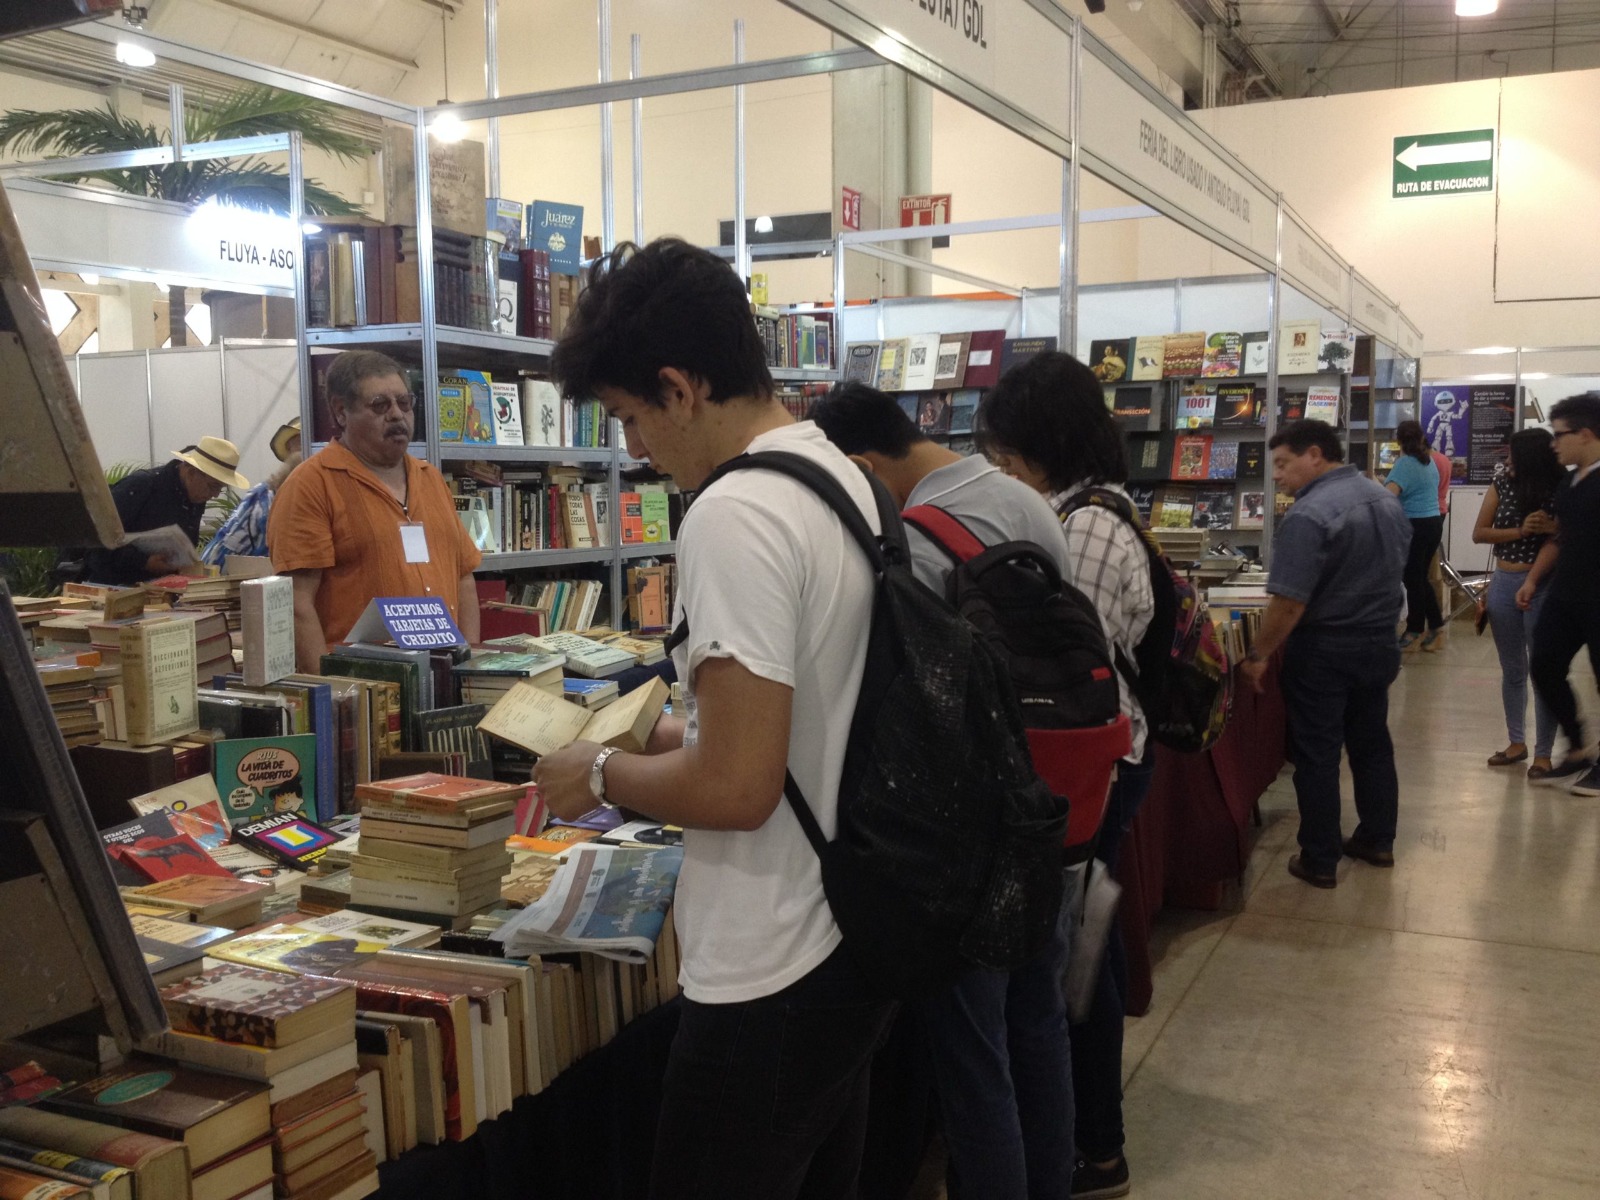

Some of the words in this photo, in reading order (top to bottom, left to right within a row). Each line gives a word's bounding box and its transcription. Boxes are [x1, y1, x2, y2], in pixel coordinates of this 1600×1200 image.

[963, 0, 987, 49] GDL
[1140, 118, 1157, 160] FERIA
[1158, 132, 1169, 169] DEL
[1170, 141, 1186, 180] LIBRO
[1396, 182, 1419, 193] RUTA
[1420, 180, 1433, 191] DE
[1433, 176, 1489, 191] EVACUACION
[902, 199, 931, 211] EXTINTOR
[541, 209, 576, 228] Juárez
[220, 240, 260, 265] FLUYA
[1185, 397, 1211, 409] 1001
[383, 603, 444, 617] ACEPTAMOS
[389, 618, 436, 632] TARJETAS
[434, 617, 451, 630] DE
[401, 631, 457, 646] CREDITO
[153, 648, 189, 662] DICCIONARIO
[257, 751, 278, 760] RIUS
[241, 763, 252, 773] LA
[252, 761, 272, 772] VIDA
[272, 760, 285, 769] DE
[247, 769, 293, 782] CUADRITOS
[103, 830, 123, 840] OTRAS
[123, 824, 142, 834] VOCES
[238, 812, 299, 837] DEMIAN
[110, 833, 130, 843] OTROS
[130, 828, 146, 837] ECOS
